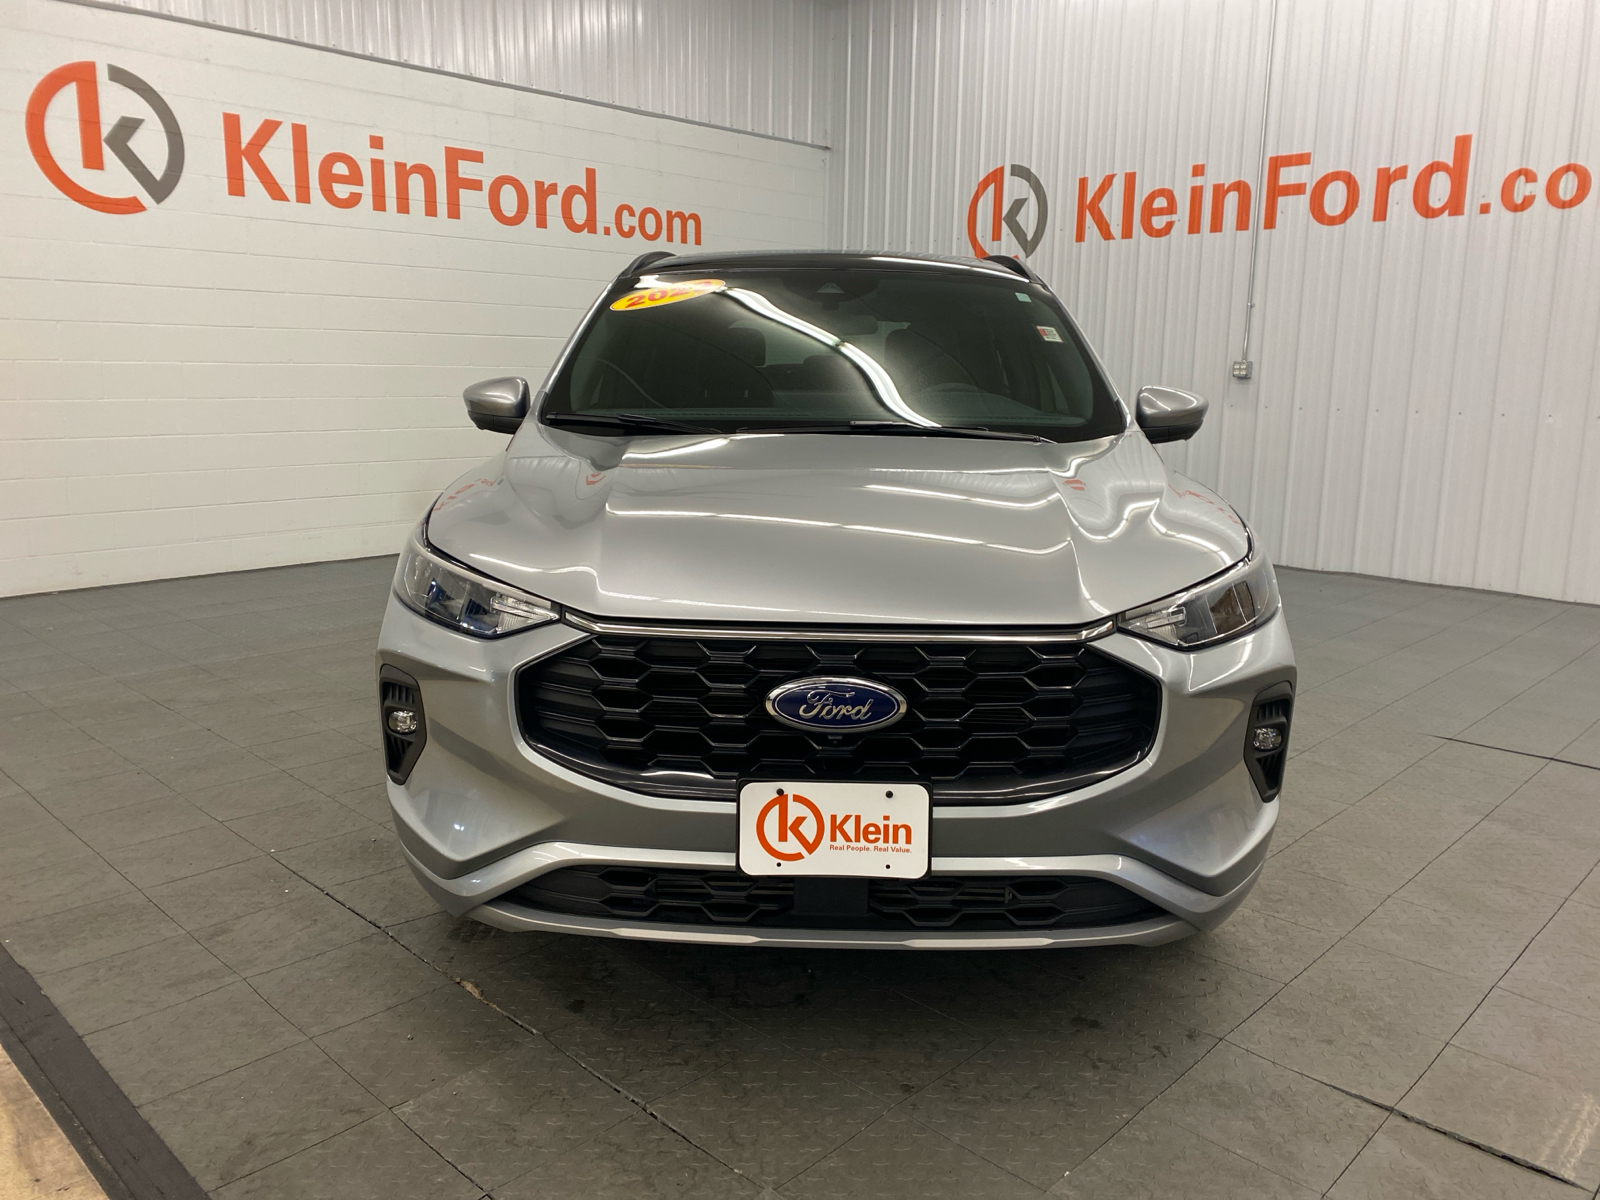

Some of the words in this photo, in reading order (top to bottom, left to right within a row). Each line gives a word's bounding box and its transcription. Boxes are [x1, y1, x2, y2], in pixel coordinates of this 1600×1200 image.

[221, 111, 703, 246] KleinFord.com
[798, 689, 874, 721] Ford
[829, 813, 912, 845] Klein
[846, 844, 872, 853] People.
[873, 845, 889, 853] Real
[890, 846, 912, 854] Value.
